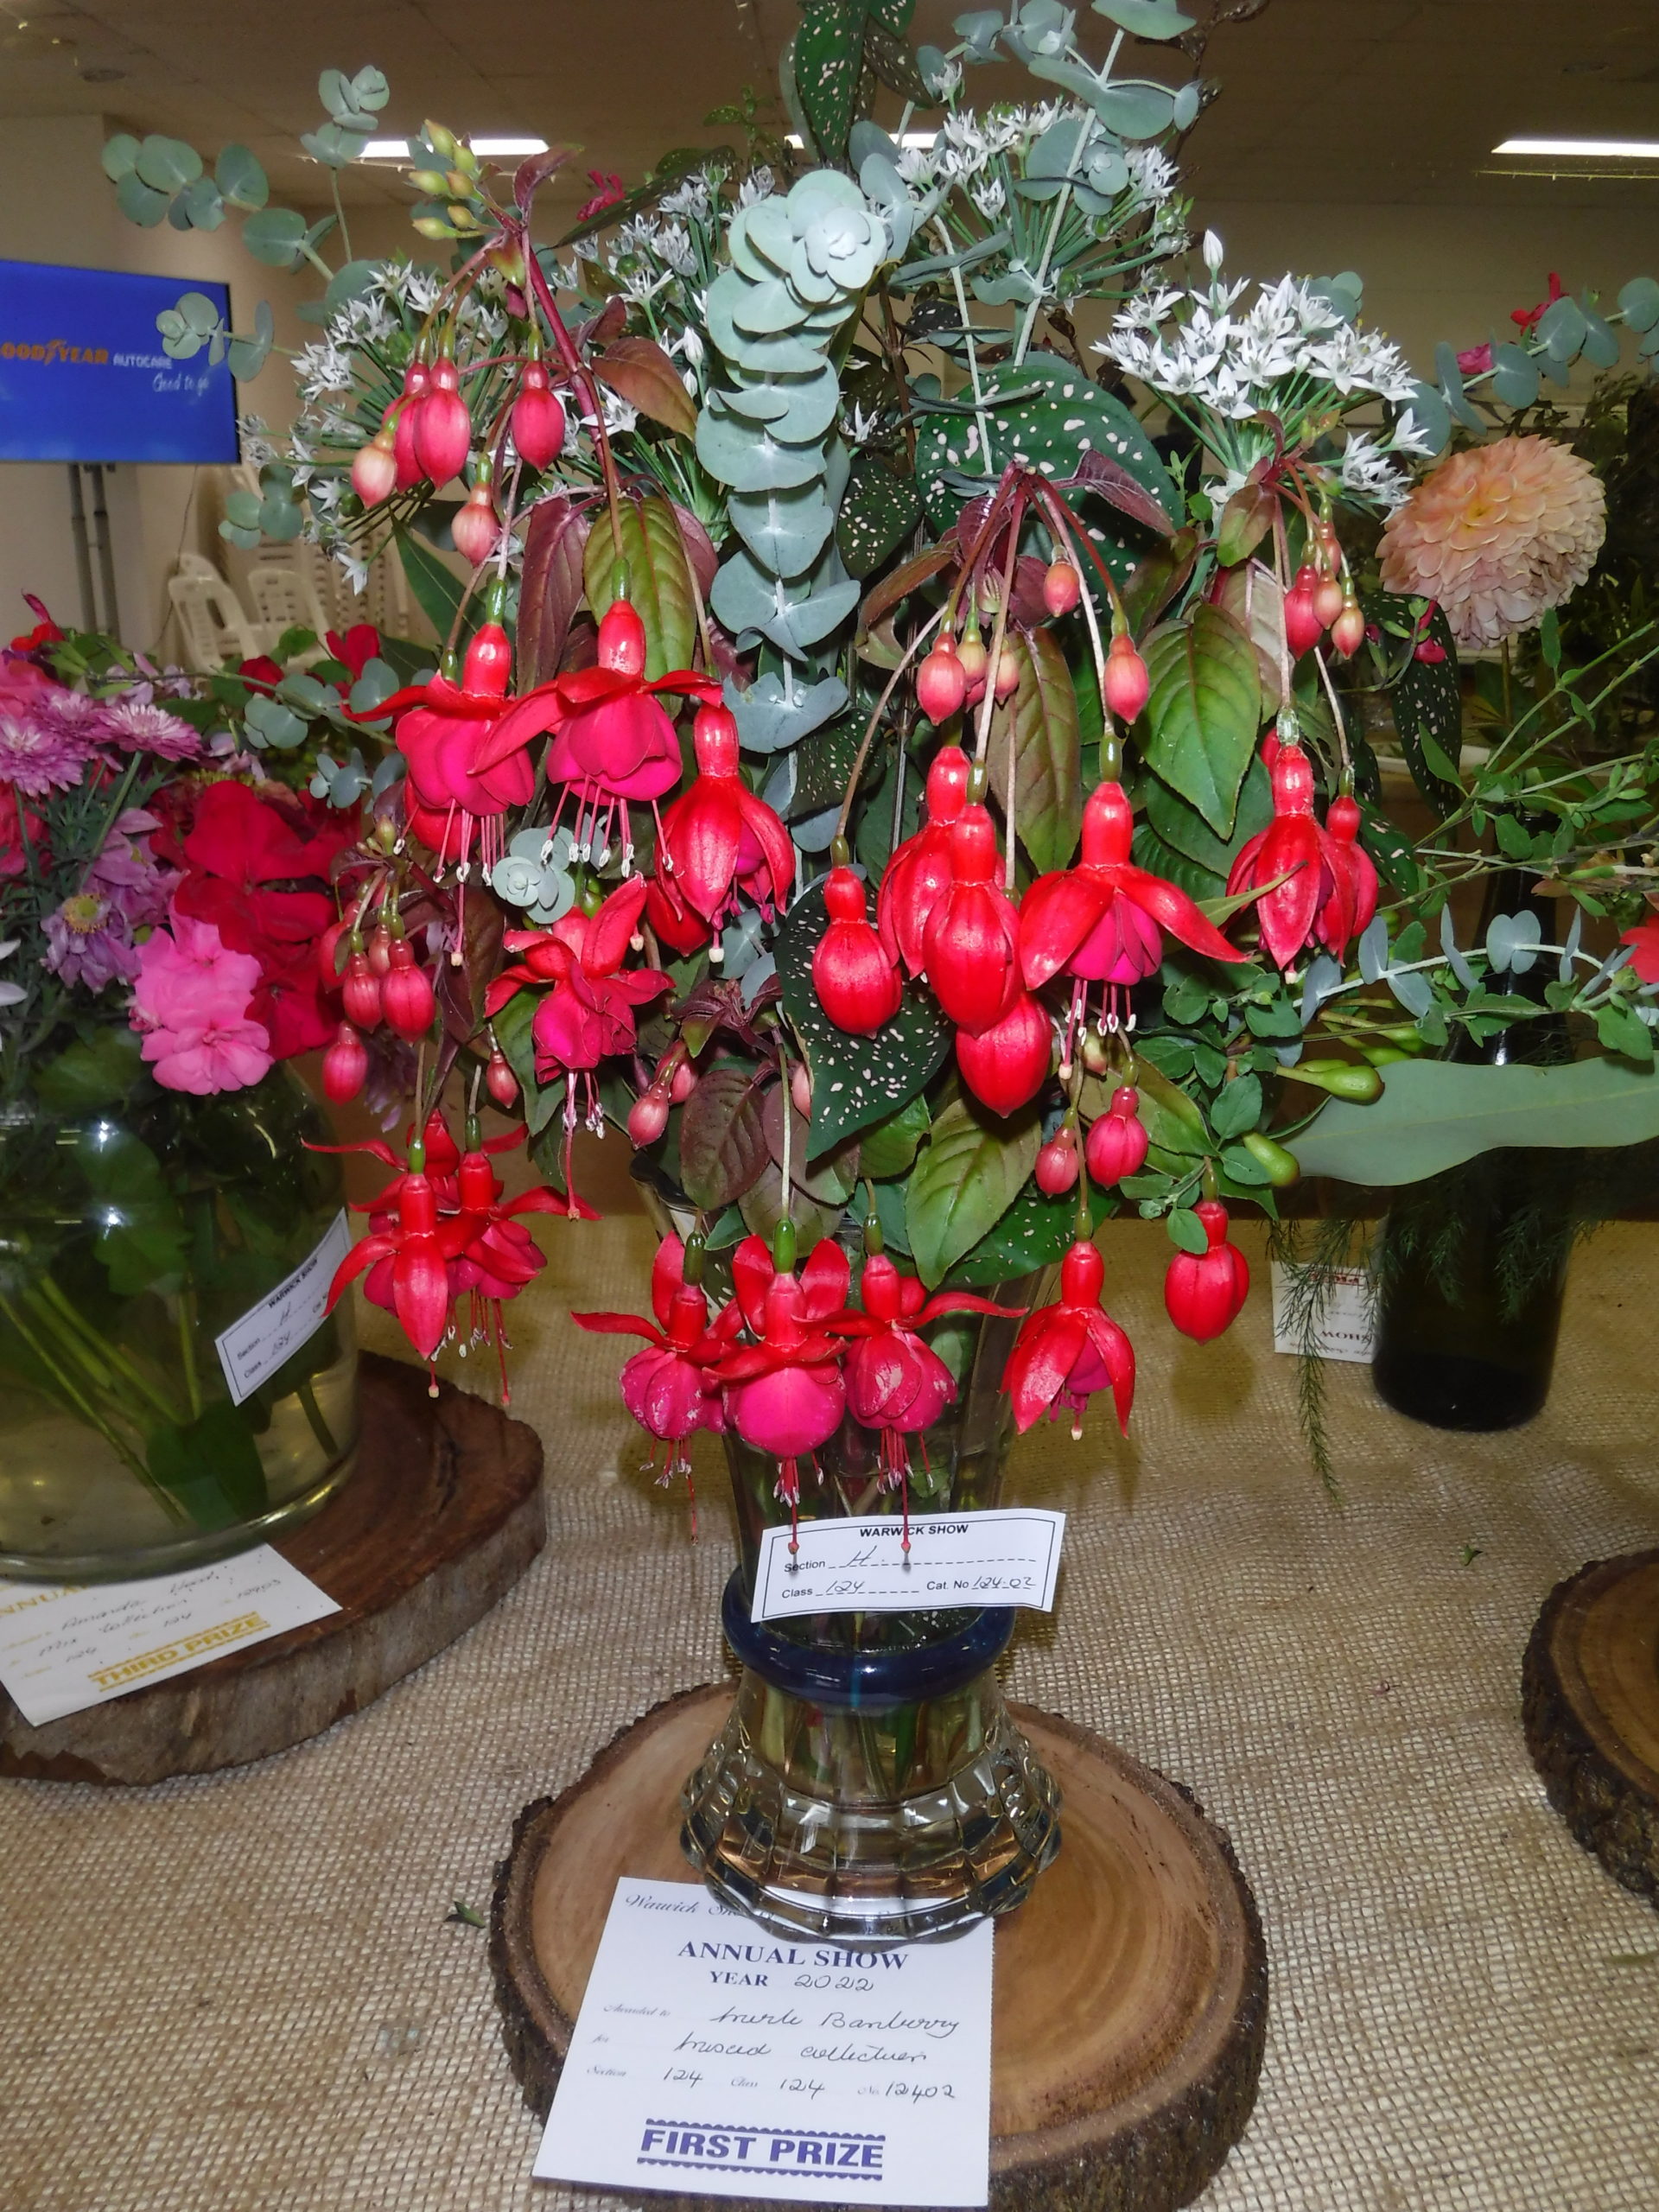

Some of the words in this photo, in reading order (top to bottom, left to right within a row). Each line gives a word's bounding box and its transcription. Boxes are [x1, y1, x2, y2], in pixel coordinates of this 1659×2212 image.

[112, 353, 172, 369] AUTOCARE
[153, 372, 181, 391] Good
[184, 374, 194, 391] to
[269, 1275, 302, 1308] WARWICK
[237, 1338, 261, 1360] Section
[244, 1361, 262, 1379] Class
[860, 1526, 925, 1537] WARWCK
[928, 1523, 969, 1535] SHOW
[784, 1560, 825, 1573] Section
[781, 1588, 813, 1599] Class
[825, 1580, 865, 1594] 124
[953, 1580, 969, 1589] No
[93, 1649, 178, 1686] THIRD
[184, 1618, 261, 1652] PRIZE
[626, 1893, 699, 1914] Warwick
[677, 1941, 805, 1966] ANNUAL
[813, 1948, 909, 1970] SHOW
[709, 1970, 769, 1987] YEAR
[794, 1974, 874, 1992] 2022
[663, 2067, 703, 2088] 124
[730, 2075, 759, 2088] Class
[779, 2078, 825, 2101] 124
[885, 2082, 956, 2105] 12402
[640, 2128, 757, 2159] FIRST
[769, 2139, 884, 2168] PRIZE
